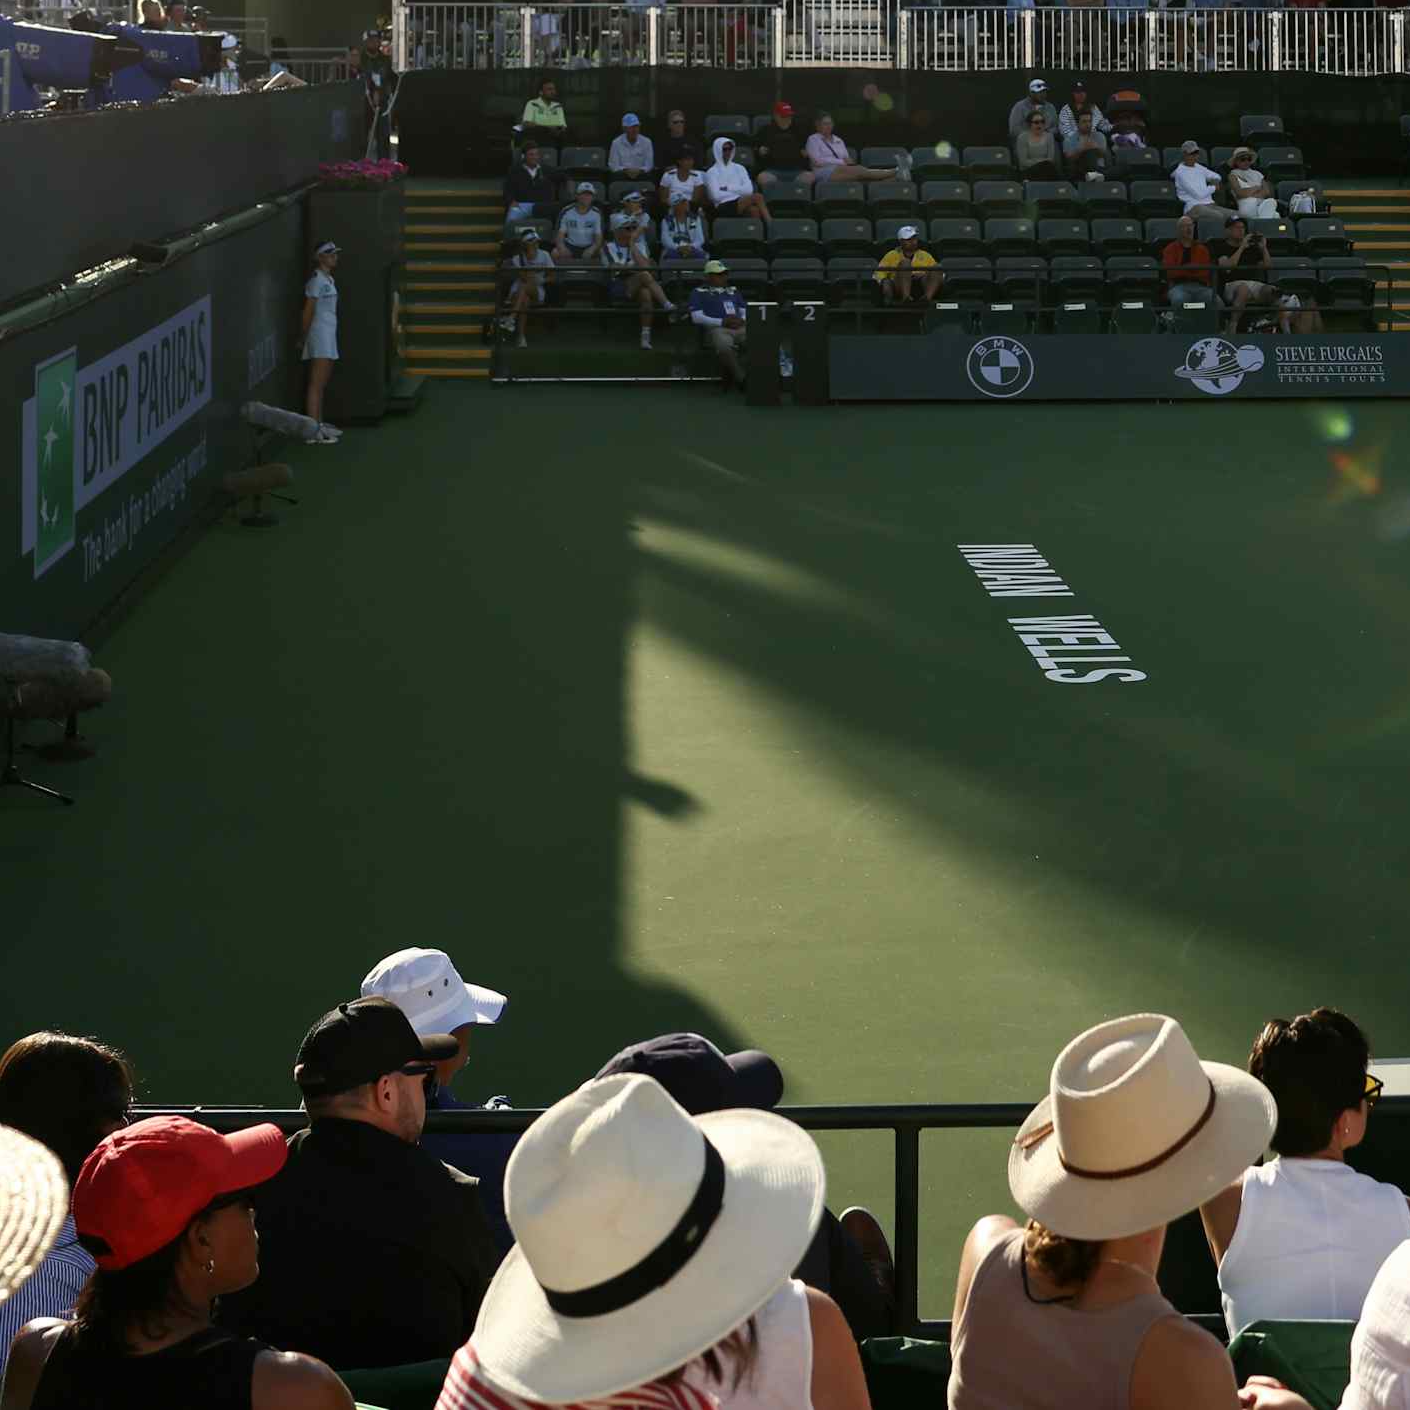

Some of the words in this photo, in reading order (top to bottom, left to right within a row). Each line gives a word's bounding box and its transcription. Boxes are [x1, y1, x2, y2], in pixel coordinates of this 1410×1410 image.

[758, 305, 767, 321] 1
[803, 305, 816, 321] 2
[975, 339, 1024, 356] BMW
[1275, 345, 1316, 362] STEVE
[1319, 345, 1383, 362] FURGAL'S
[83, 363, 128, 486] BNP
[136, 310, 206, 443] PARIBAS
[957, 544, 1075, 597] INDIAN
[1007, 614, 1147, 683] WELLS
